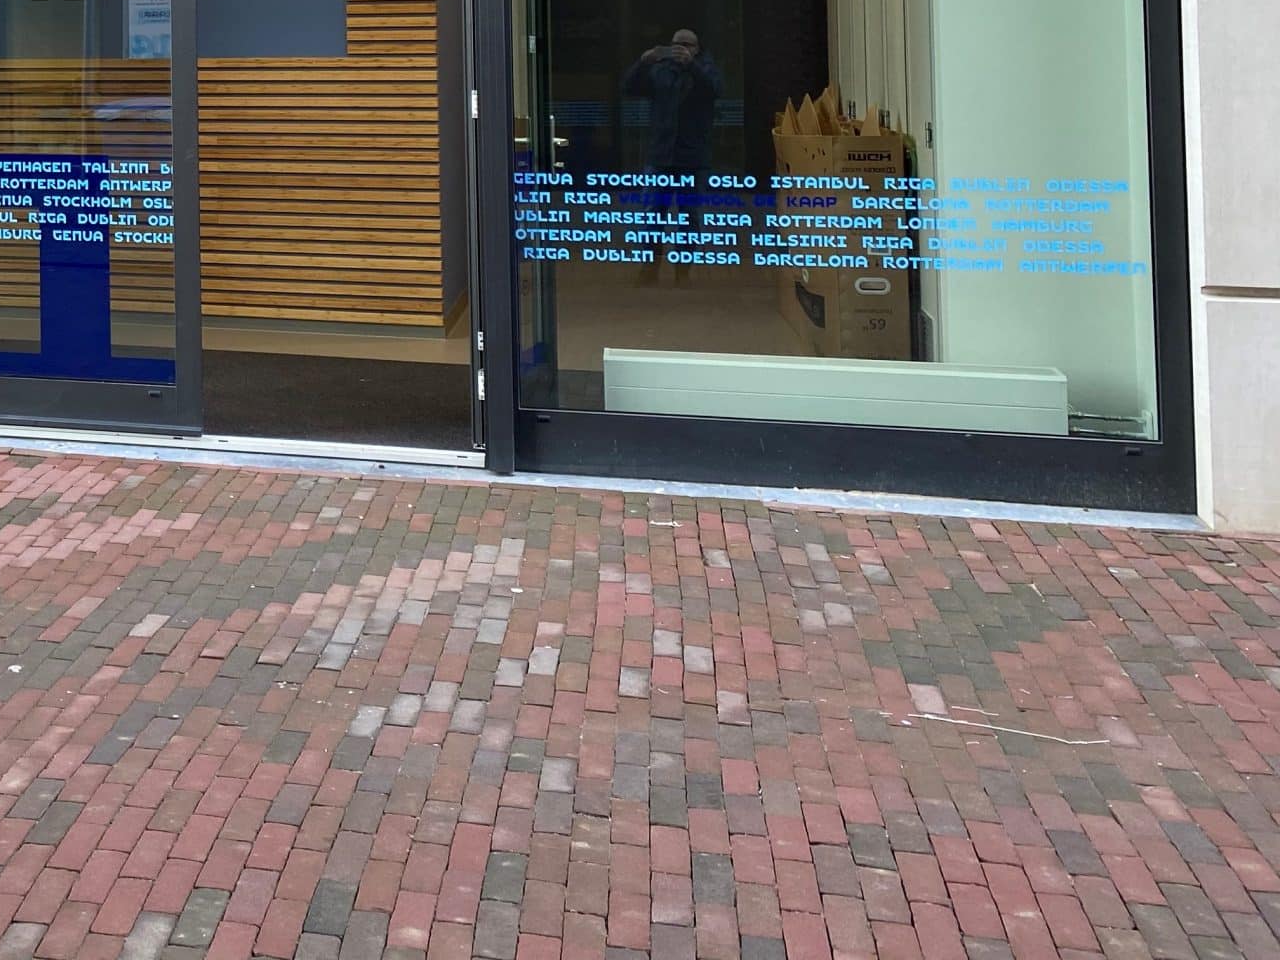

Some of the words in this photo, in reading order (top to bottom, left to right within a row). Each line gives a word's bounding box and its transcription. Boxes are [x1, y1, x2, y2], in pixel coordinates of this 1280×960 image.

[82, 162, 149, 174] TALLINN
[0, 178, 89, 190] ROTTERDAM
[513, 172, 573, 185] GENUA
[586, 173, 695, 187] STOCKHOLM
[708, 175, 757, 188] OSLO
[770, 176, 869, 190] ISTANBUL
[884, 177, 936, 190] RIGA
[1045, 178, 1129, 193] ODESSA
[43, 195, 132, 208] STOCKHOLM
[143, 197, 174, 209] OSL
[514, 191, 551, 204] LIN
[564, 192, 612, 205] RIGA
[786, 195, 837, 208] KAAP
[852, 196, 969, 210] BARCELONA
[28, 212, 67, 224] RIGA
[77, 213, 137, 226] DUBLIN
[584, 211, 690, 226] MARSEILLE
[703, 214, 753, 227] RIGA
[766, 214, 882, 229] ROTTERDAM
[897, 217, 977, 231] LONDEN
[52, 229, 104, 242] GENUA
[624, 231, 738, 246] ANTWERPEN
[751, 233, 847, 248] HELSINKI
[862, 236, 913, 250] RIGA
[1023, 239, 1105, 254] ODESSA
[524, 247, 570, 260] RIGA
[582, 248, 654, 262] DUBLIN
[667, 250, 741, 265] ODESSA
[754, 252, 869, 268] BARCELONA
[882, 256, 1004, 272] ROTTERDAM
